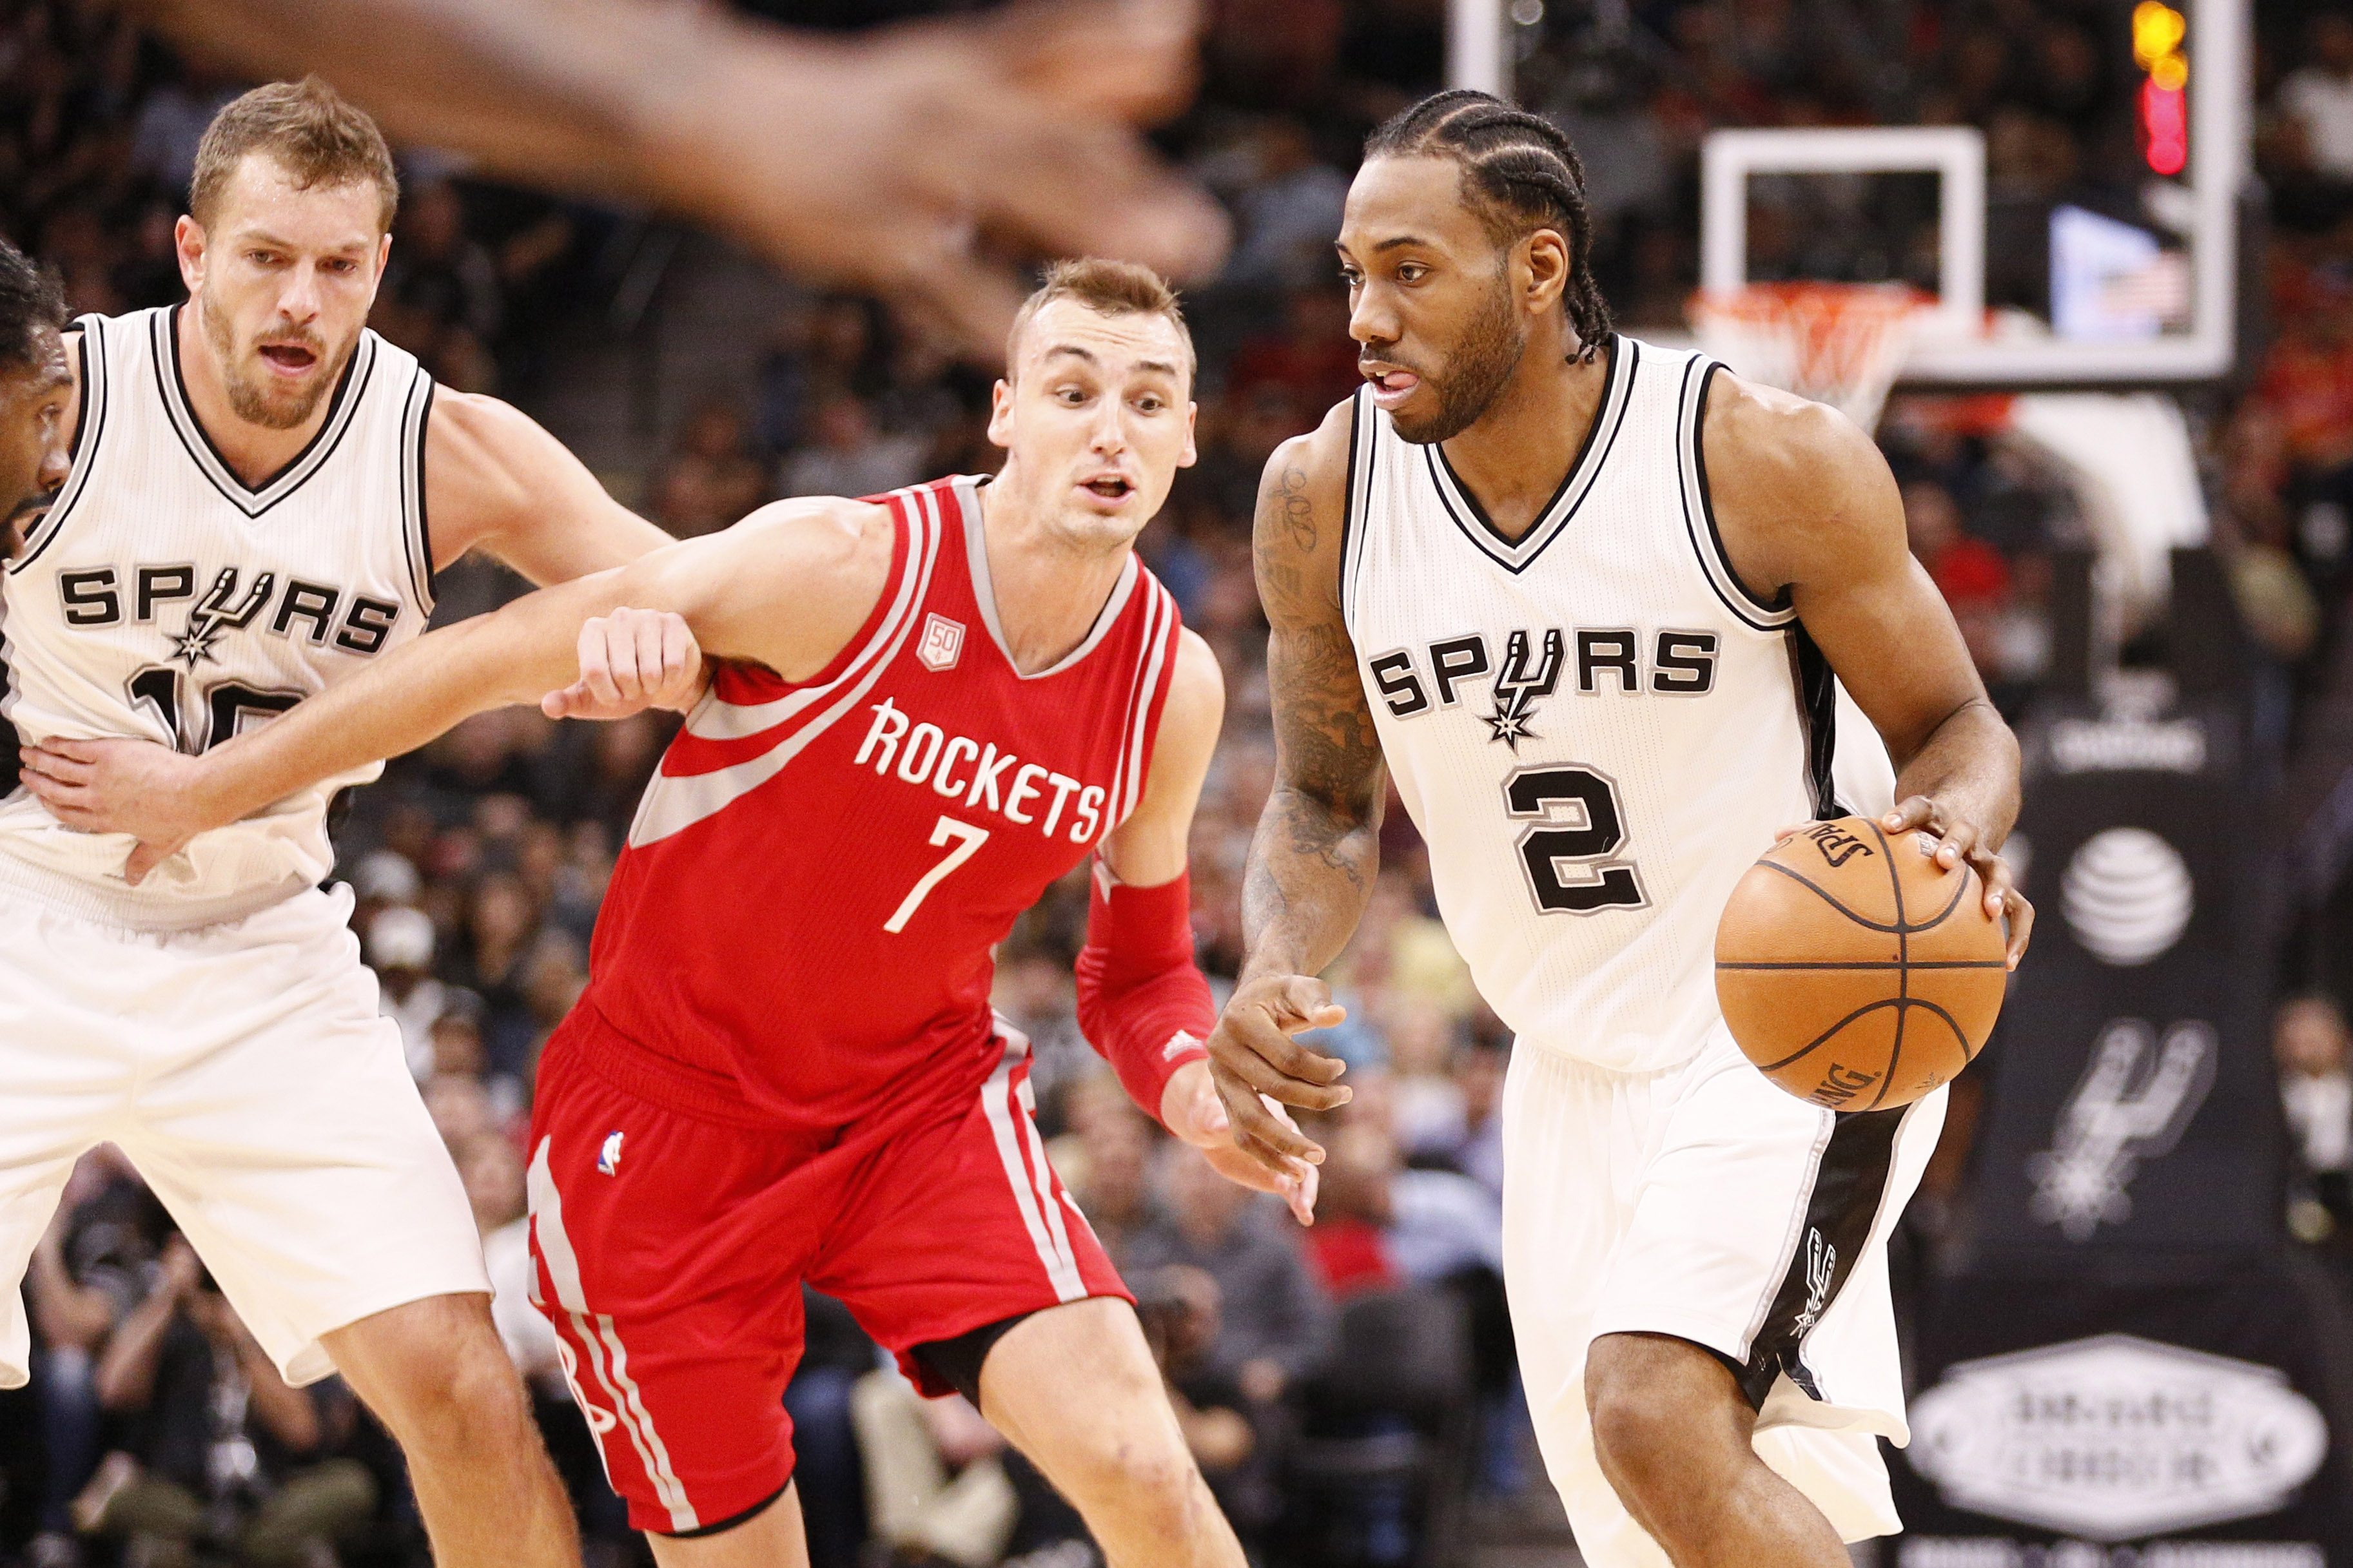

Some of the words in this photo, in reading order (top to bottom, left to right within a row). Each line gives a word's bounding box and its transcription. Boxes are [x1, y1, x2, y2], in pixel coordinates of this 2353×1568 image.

[55, 561, 402, 672] SPURS
[930, 624, 957, 652] 50
[1369, 624, 1721, 753] SPURS
[854, 697, 1106, 844] ROCKETS
[883, 815, 990, 934] 7
[1501, 761, 1653, 916] 2
